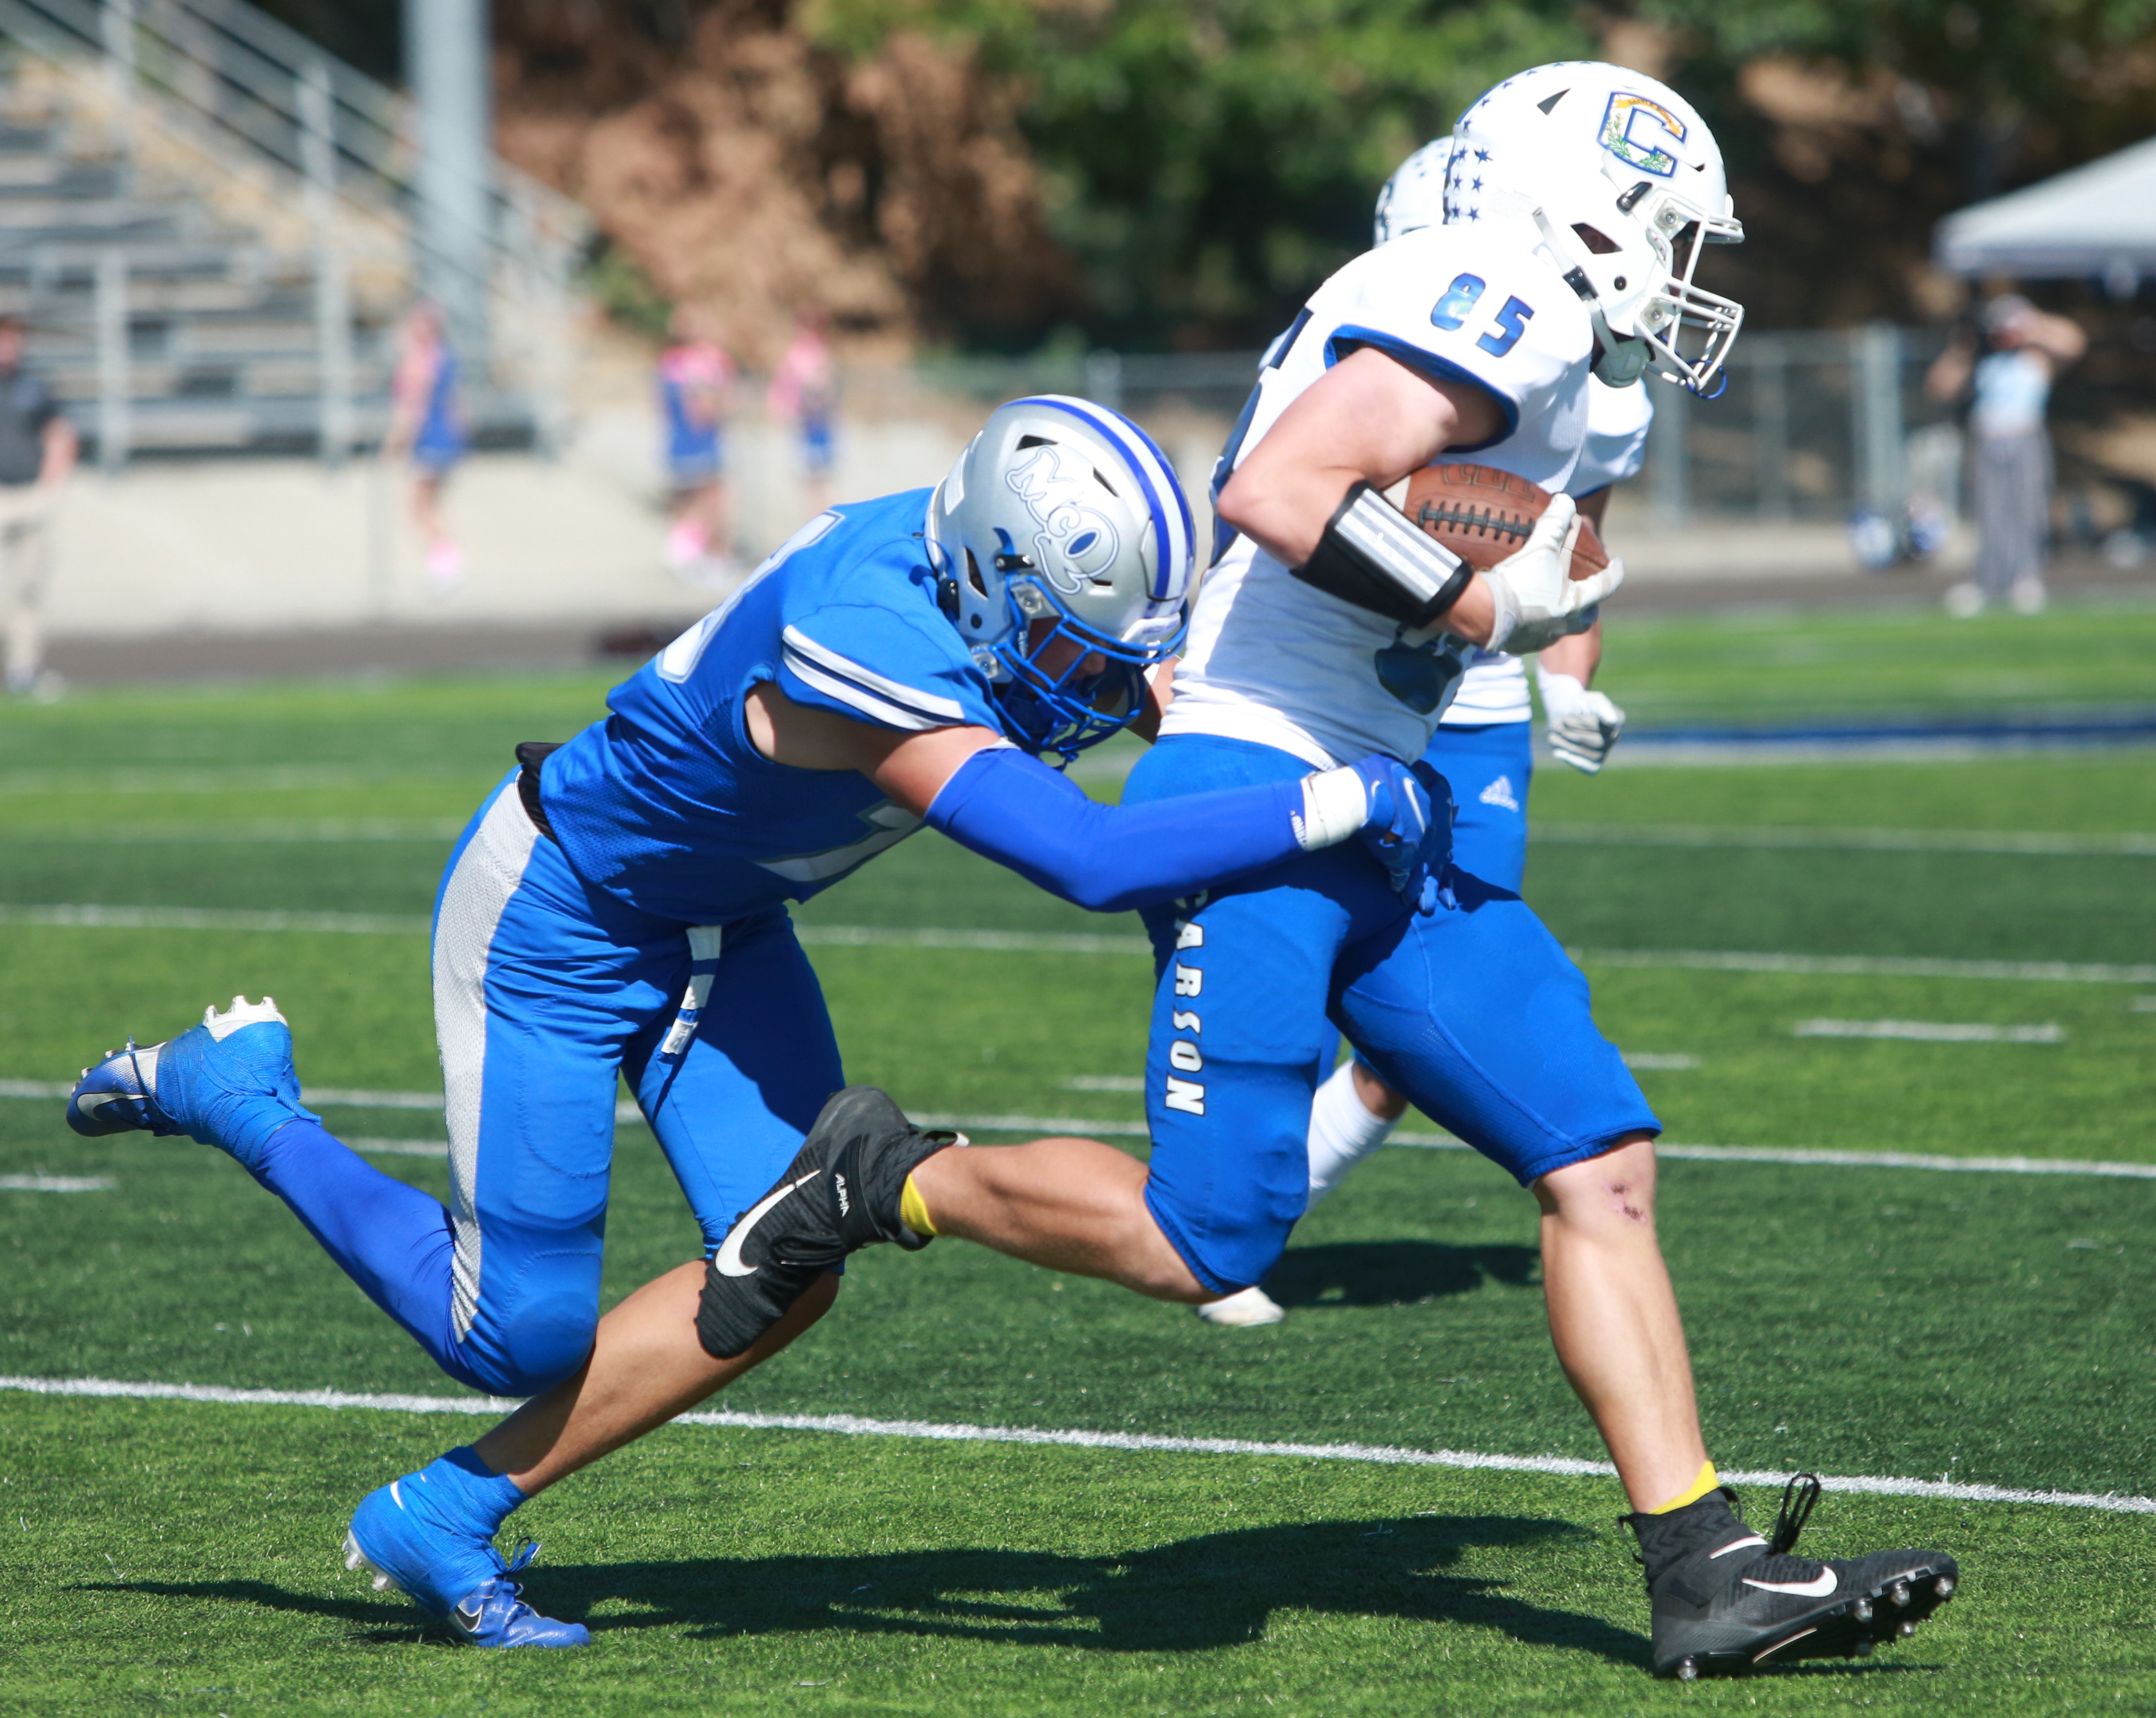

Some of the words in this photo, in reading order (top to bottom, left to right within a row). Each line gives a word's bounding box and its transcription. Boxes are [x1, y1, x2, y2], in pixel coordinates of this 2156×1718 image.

[1597, 91, 1688, 178] C
[1431, 272, 1535, 358] 85
[835, 1173, 850, 1218] ALPHA
